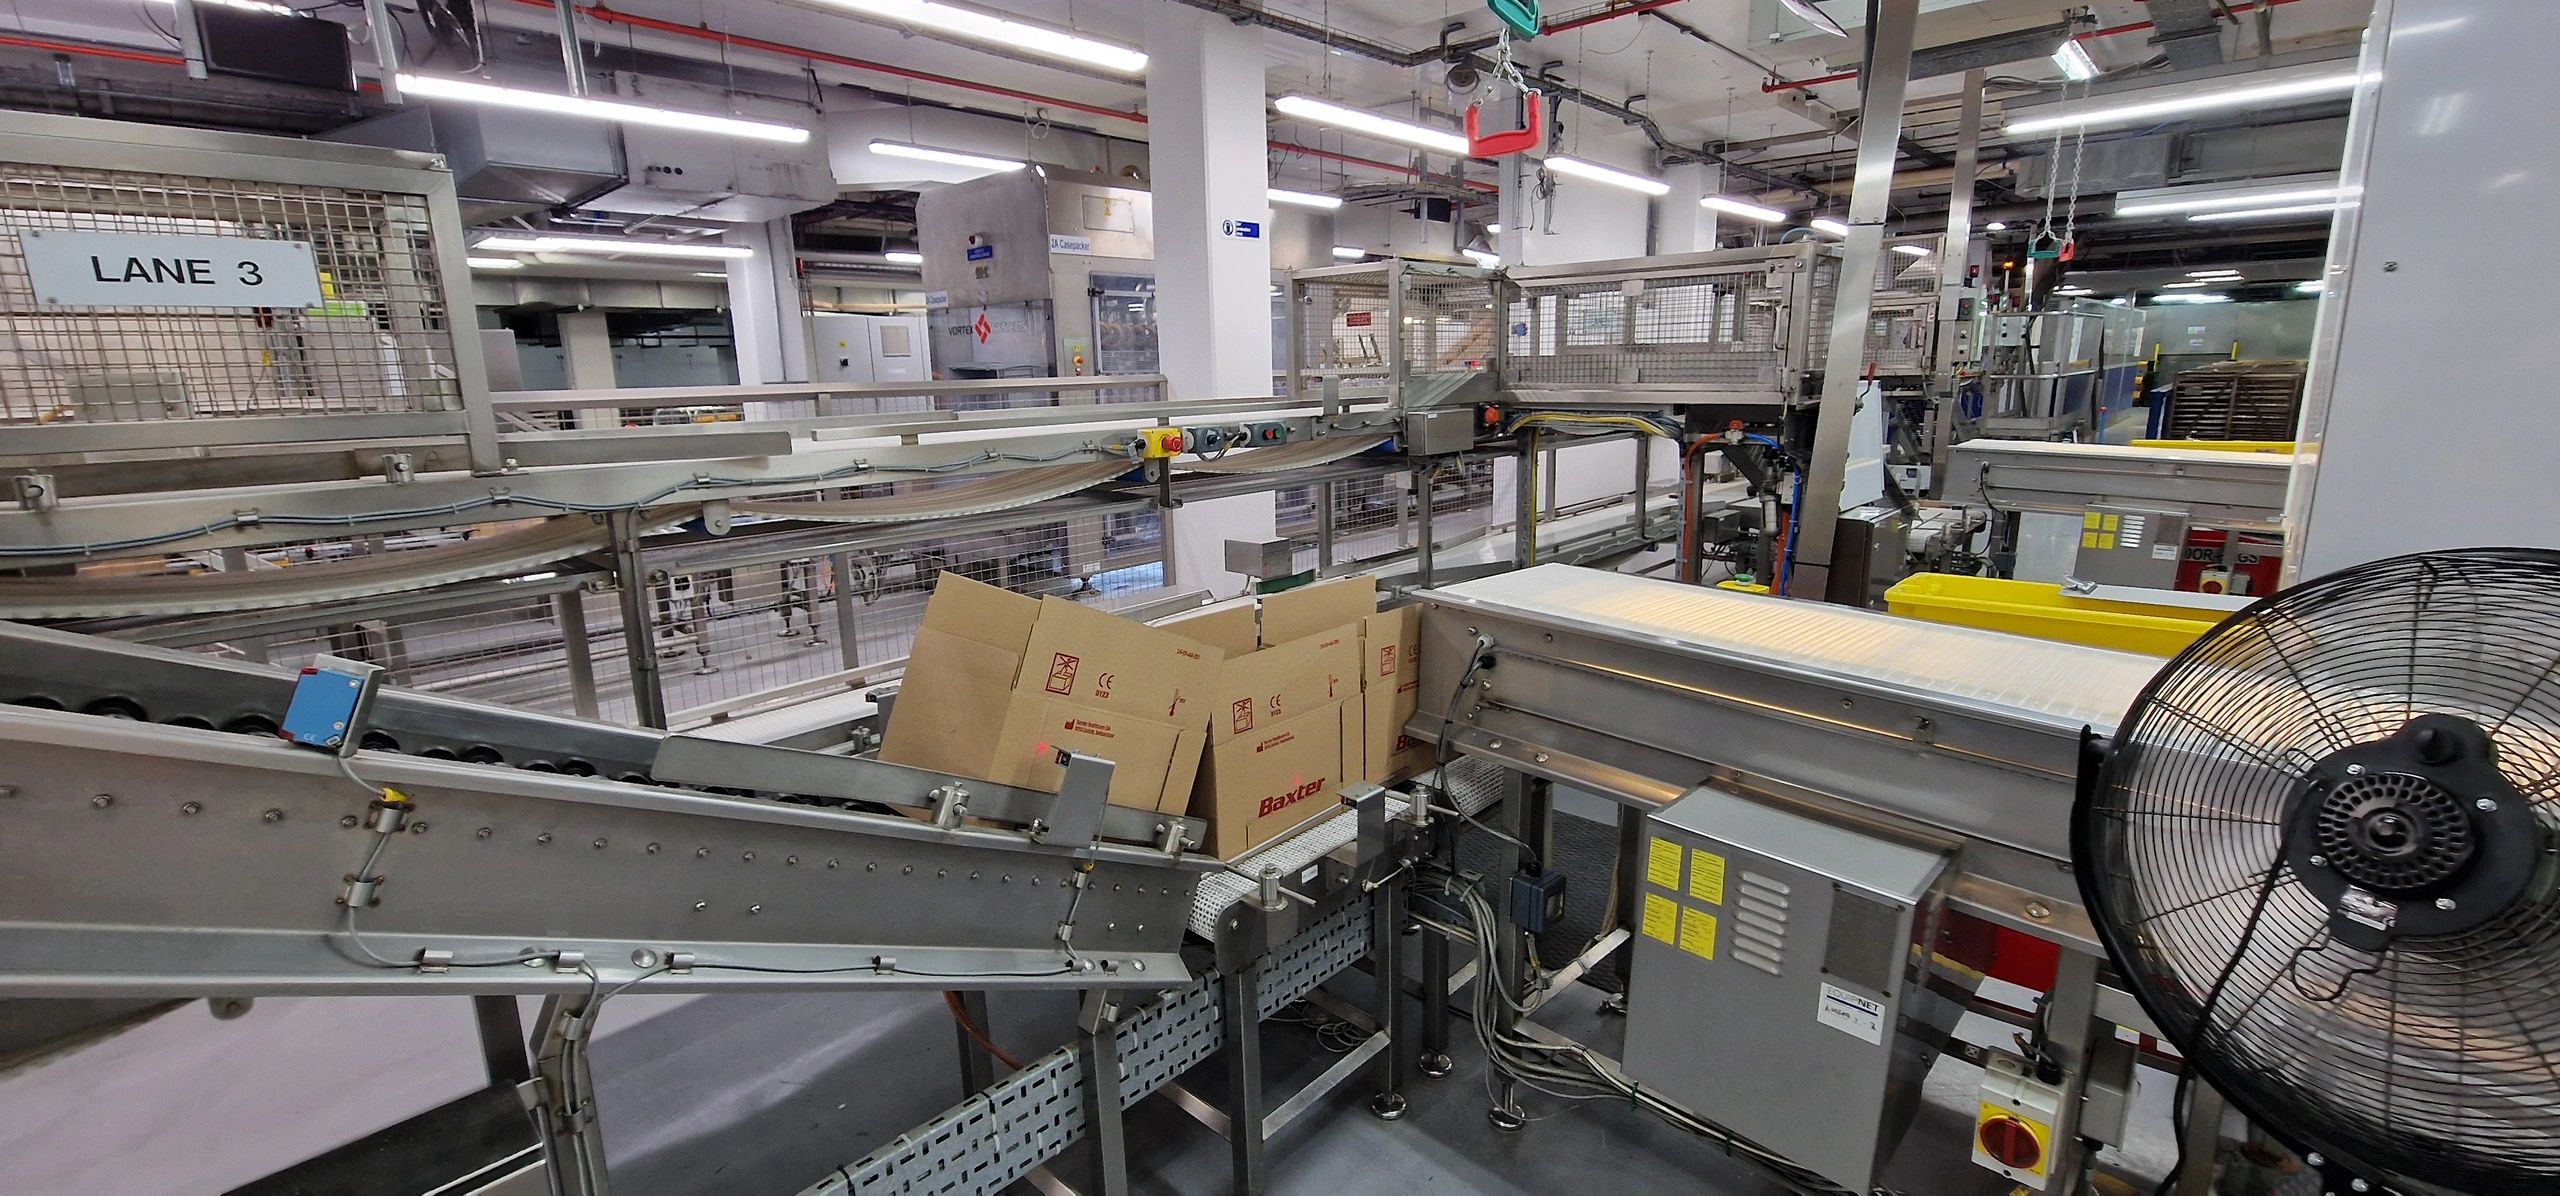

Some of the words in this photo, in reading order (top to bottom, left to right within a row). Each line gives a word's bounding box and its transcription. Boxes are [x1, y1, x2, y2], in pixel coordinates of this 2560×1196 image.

[91, 256, 215, 284] LANE
[237, 261, 263, 286] 3
[948, 326, 974, 336] VORTEX
[1258, 777, 1326, 818] Baxter
